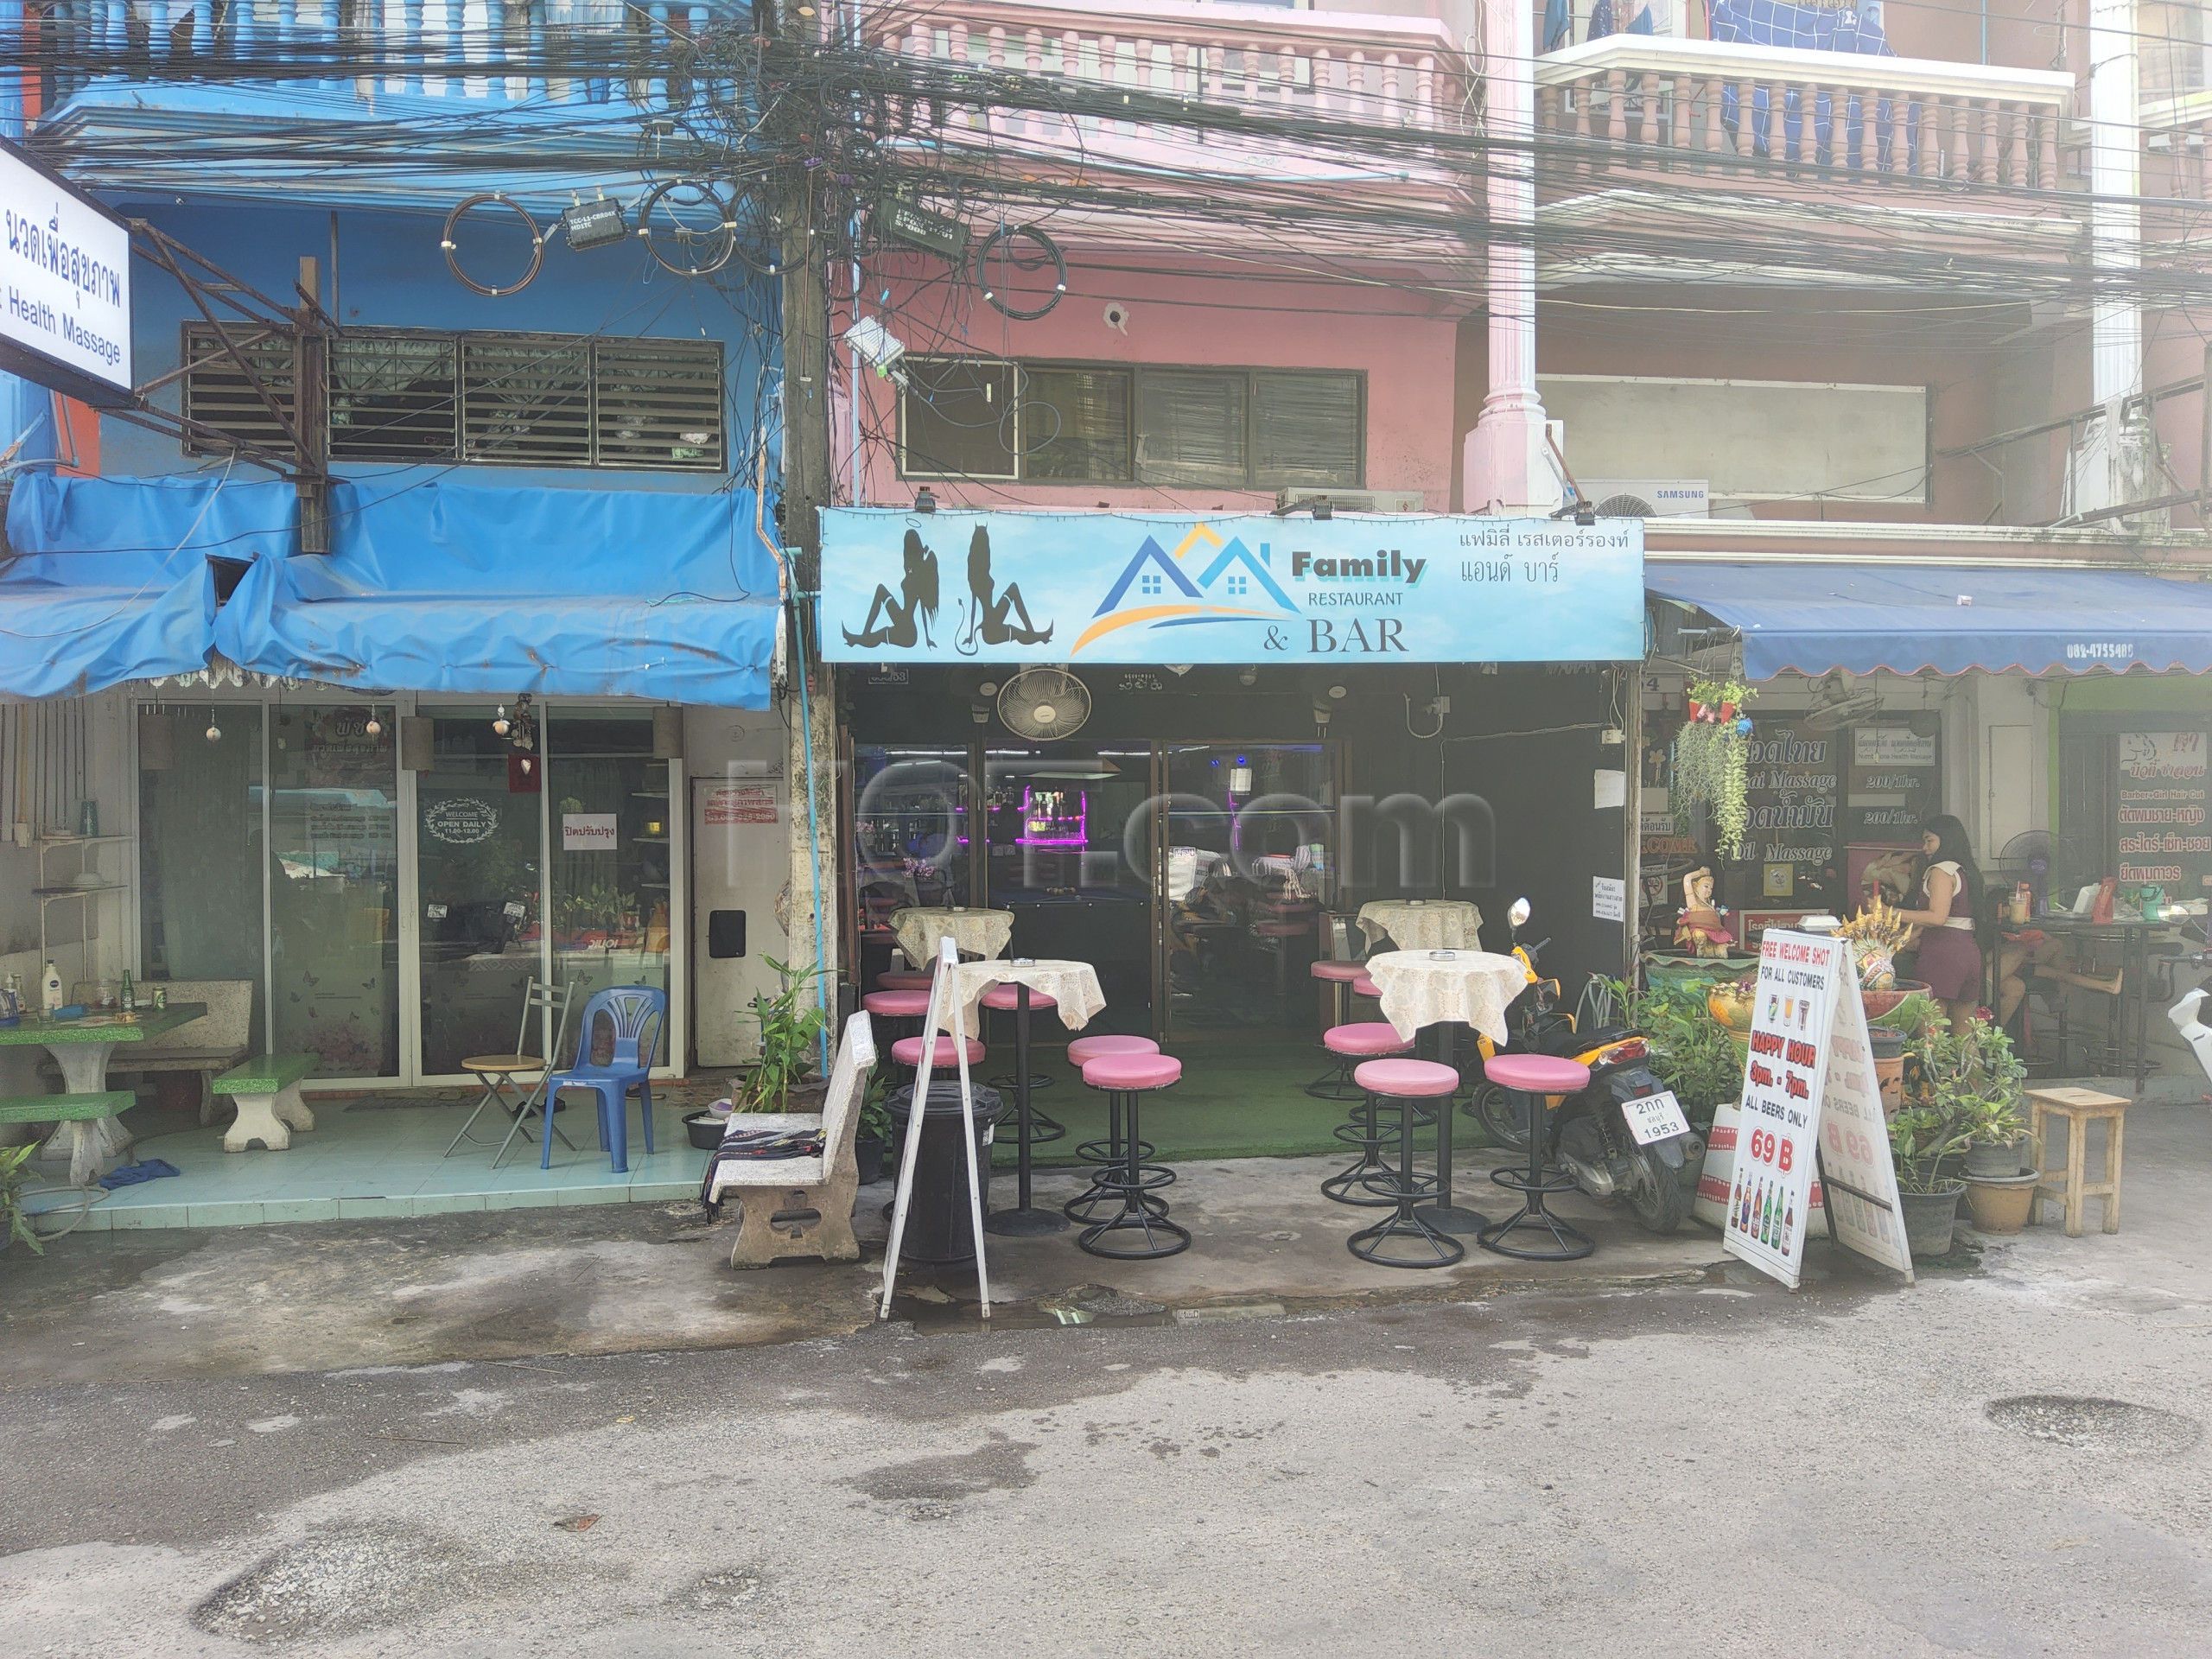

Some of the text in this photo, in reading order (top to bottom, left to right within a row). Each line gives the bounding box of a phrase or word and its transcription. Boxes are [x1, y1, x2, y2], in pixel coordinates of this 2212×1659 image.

[6, 201, 120, 308] นวดเพื่อสุขภาพ
[10, 286, 120, 365] Health Massage
[1657, 490, 1704, 499] SAMSUNG
[1460, 524, 1629, 548] แฟมิลี่ เรสเตอร์รองท์
[1293, 550, 1429, 588] Family
[1524, 552, 1559, 582] บาร์
[1309, 592, 1403, 606] RESTAURANT
[1263, 618, 1409, 653] & BAR
[1769, 770, 1837, 793] Massage
[1745, 789, 1834, 830] วดน้ำมัน
[565, 825, 615, 840] ปิดปรับปรุง
[1764, 843, 1833, 866] Massage
[1762, 940, 1778, 959] FREE
[1779, 943, 1811, 963] WELCOME
[1812, 947, 1831, 966] SHOT
[1760, 966, 1825, 991] FOR ALL CUSTOMERS
[1751, 1030, 1817, 1069] HAPPY HOUR
[1750, 1060, 1773, 1088] 3pm.
[1785, 1071, 1810, 1100] 7pm.
[1636, 1098, 1665, 1115] 2กก
[1745, 1094, 1808, 1129] ALL BEERS ONLY
[1644, 1122, 1680, 1139] 1953
[1751, 1126, 1776, 1166] 69
